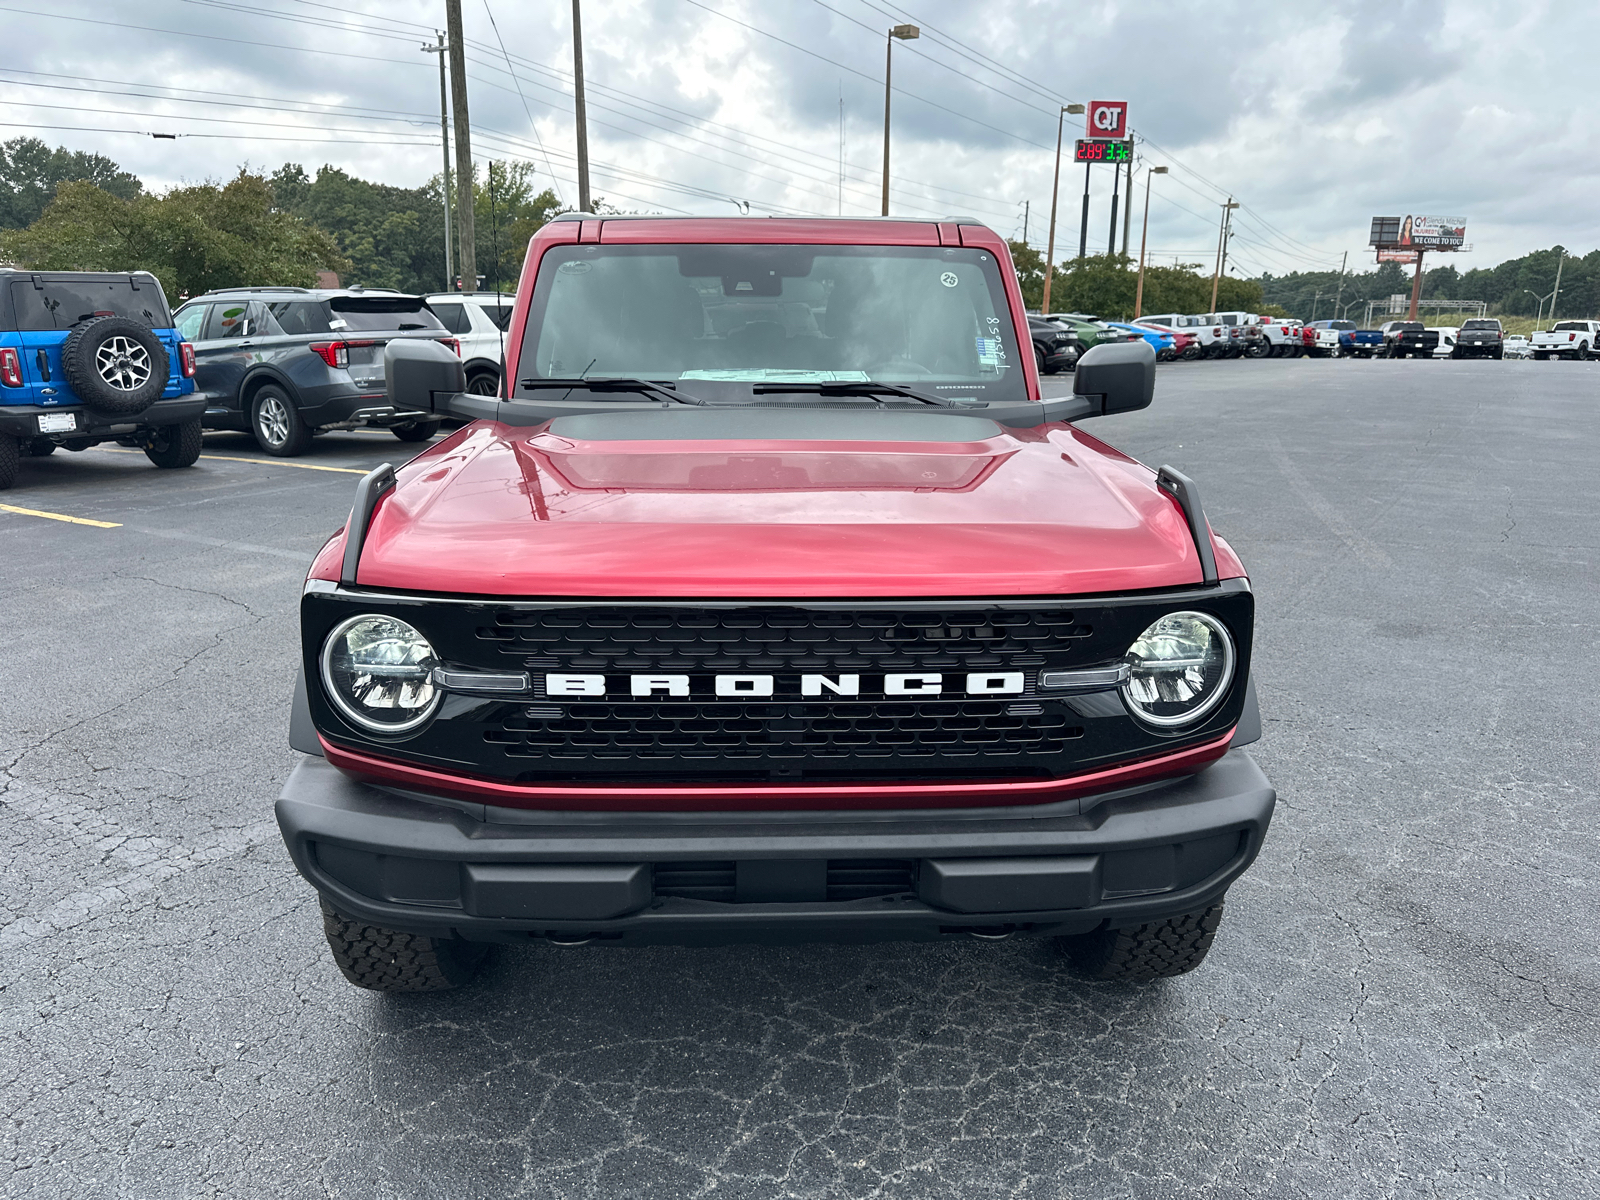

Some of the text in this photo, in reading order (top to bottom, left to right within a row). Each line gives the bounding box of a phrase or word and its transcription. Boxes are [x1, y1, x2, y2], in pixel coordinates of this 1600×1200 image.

[1093, 106, 1122, 131] QT
[942, 273, 957, 286] 25
[545, 672, 1025, 697] BRONCO
